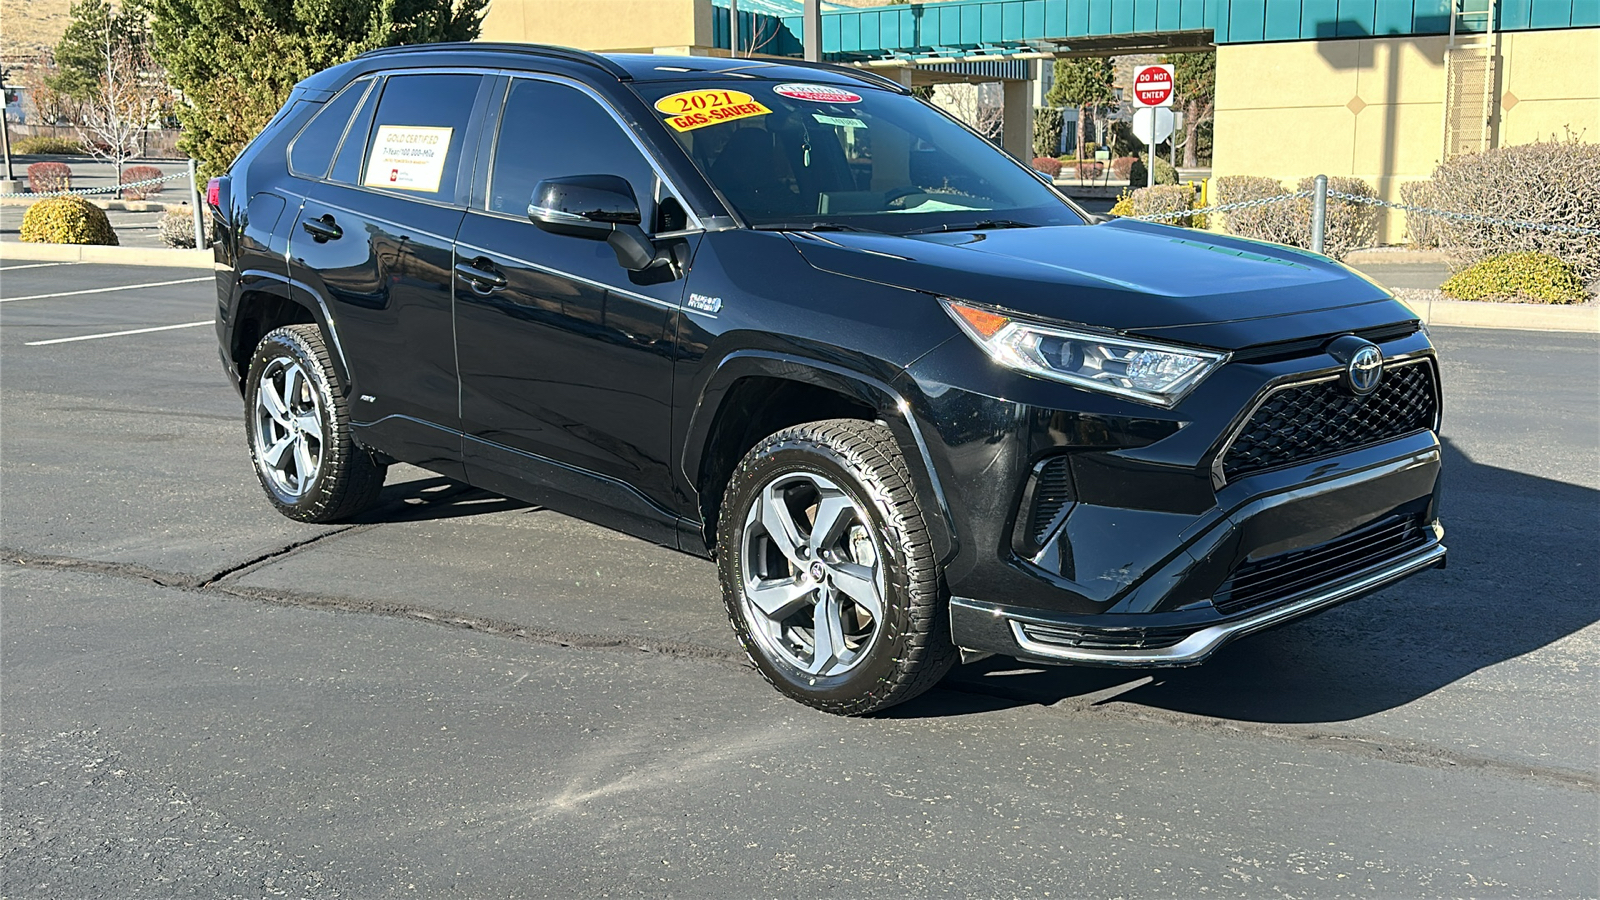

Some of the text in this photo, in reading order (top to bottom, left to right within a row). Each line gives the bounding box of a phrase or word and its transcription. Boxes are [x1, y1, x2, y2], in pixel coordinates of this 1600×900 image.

[1153, 73, 1168, 81] NOT
[1142, 91, 1165, 99] ENTER
[675, 92, 735, 112] 2021
[673, 103, 761, 128] GAS-SAVER
[386, 133, 439, 145] GOLD CERTIFIED
